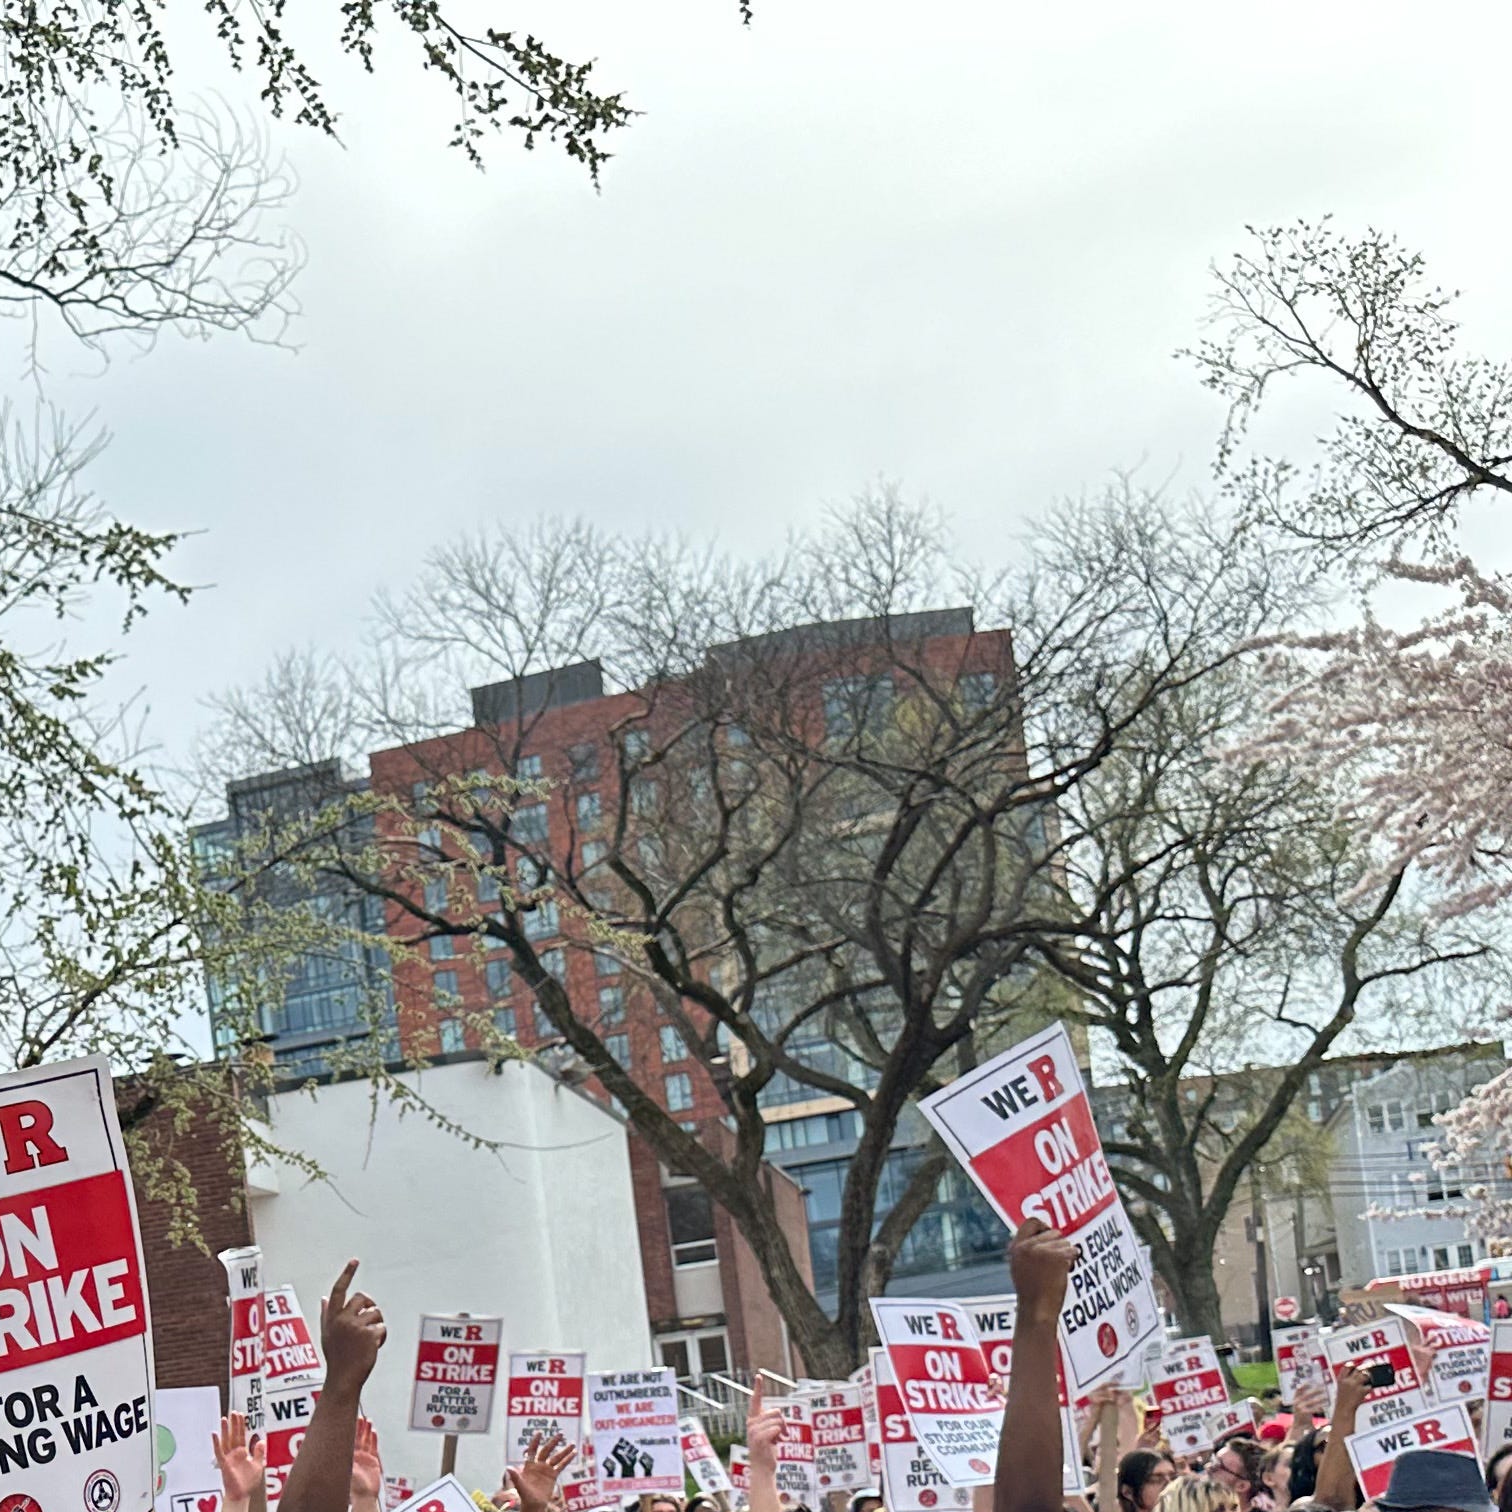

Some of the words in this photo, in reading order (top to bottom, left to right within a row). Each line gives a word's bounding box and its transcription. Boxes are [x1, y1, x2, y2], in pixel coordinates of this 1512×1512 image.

[981, 1075, 1038, 1121] WE
[1026, 1054, 1065, 1104] R
[1034, 1116, 1080, 1176] ON
[1021, 1150, 1114, 1230] STRIKE
[1086, 1215, 1124, 1255] EQUAL
[1071, 1262, 1101, 1299] PAY
[1102, 1245, 1125, 1277] FOR
[277, 1296, 292, 1315] R
[1062, 1292, 1116, 1336] EQUAL
[1111, 1259, 1143, 1298] WORK
[904, 1316, 937, 1335] WE
[936, 1312, 964, 1340] R
[975, 1312, 1011, 1331] WE
[269, 1323, 297, 1346] ON
[441, 1326, 462, 1338] WE
[465, 1325, 482, 1340] R
[1346, 1337, 1371, 1353] WE
[1371, 1330, 1389, 1347] R
[266, 1343, 318, 1375] STRIKE
[443, 1346, 475, 1364] ON
[420, 1361, 494, 1381] STRIKE
[527, 1361, 546, 1372] WE
[549, 1359, 566, 1374] R
[924, 1351, 962, 1380] ON
[1163, 1361, 1185, 1375] WE
[1186, 1357, 1203, 1370] R
[530, 1380, 559, 1396] ON
[602, 1376, 617, 1386] WE
[620, 1374, 639, 1385] ARE
[642, 1372, 662, 1383] NOT
[1174, 1377, 1201, 1395] ON
[73, 1374, 100, 1412] A
[432, 1395, 475, 1405] BETTER
[438, 1386, 461, 1395] FOR
[830, 1394, 846, 1406] R
[906, 1380, 1000, 1410] STRIKE
[1160, 1385, 1224, 1414] STRIKE
[271, 1397, 309, 1421] WE
[426, 1403, 478, 1415] RUTGERS
[511, 1397, 579, 1414] STRIKE
[616, 1403, 631, 1414] WE
[1372, 1401, 1396, 1414] FOR
[61, 1395, 149, 1456] WAGE
[816, 1414, 842, 1427] ON
[937, 1420, 962, 1431] FOR
[964, 1418, 993, 1430] OUR
[1370, 1406, 1412, 1426] BETTER
[814, 1425, 862, 1444] TRIKE
[925, 1430, 994, 1444] STUDENTS
[1377, 1431, 1414, 1453] WE
[1413, 1419, 1448, 1446] R
